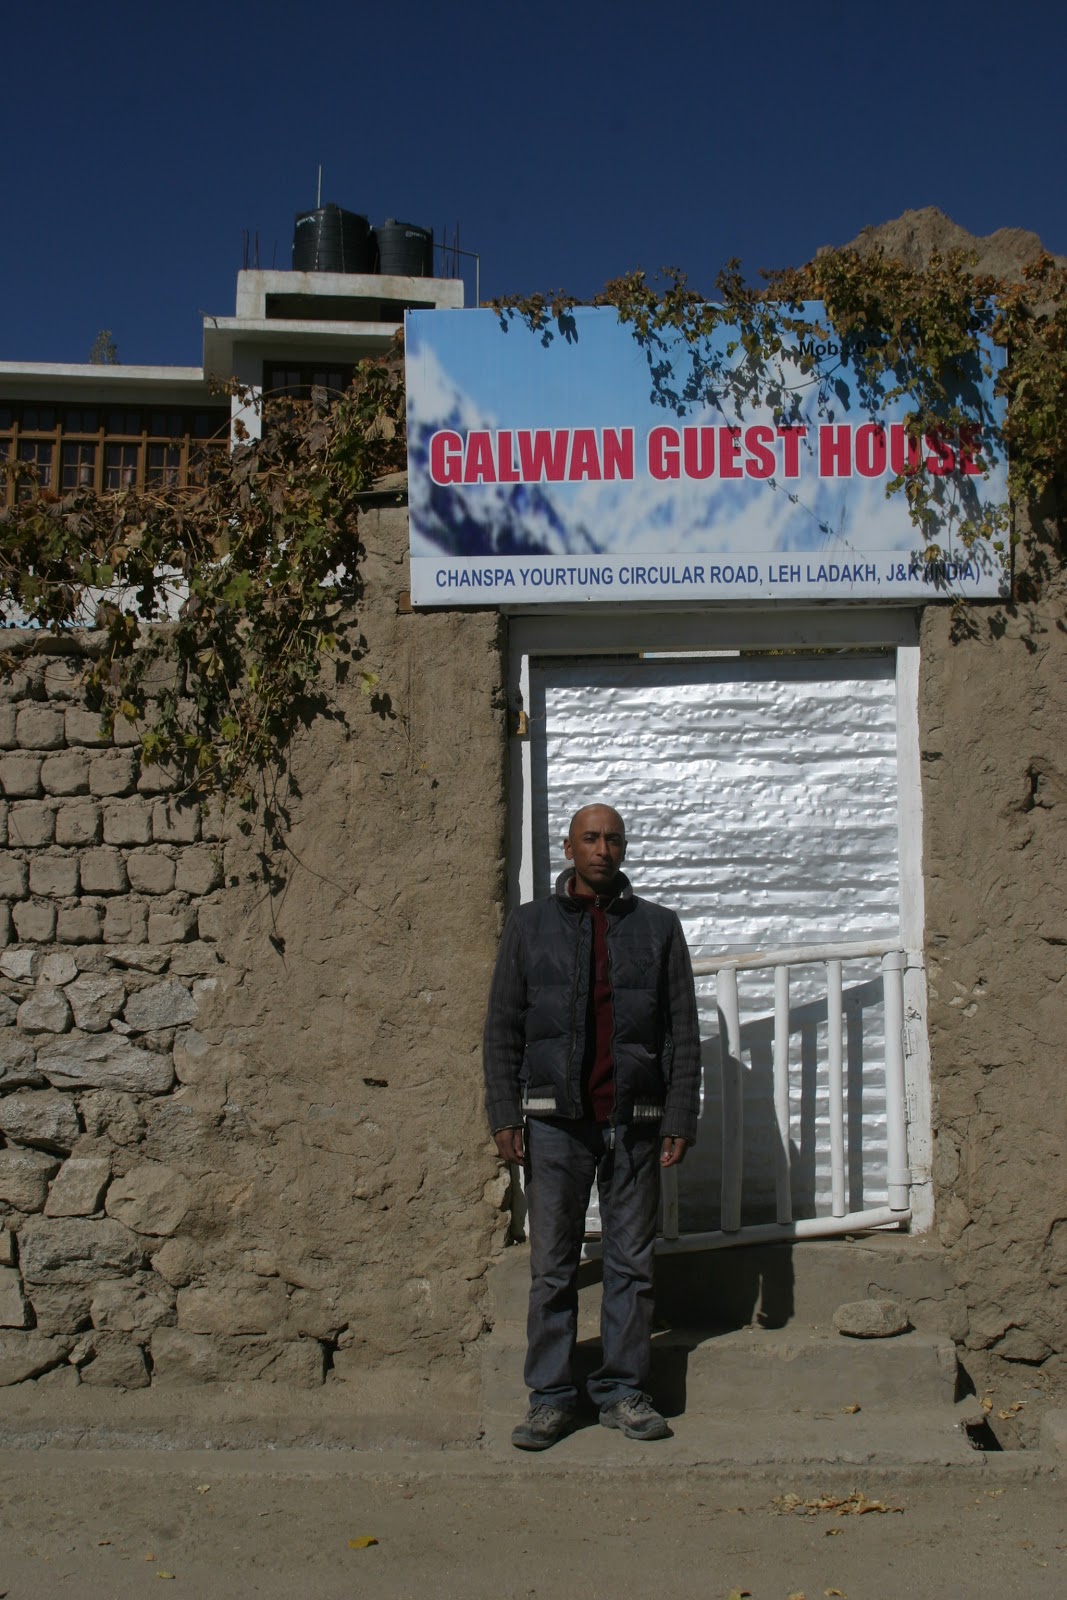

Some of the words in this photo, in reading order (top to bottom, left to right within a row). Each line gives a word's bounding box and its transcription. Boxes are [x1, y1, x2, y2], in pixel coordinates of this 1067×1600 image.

[431, 428, 634, 486] GALWAN
[648, 423, 807, 481] GUEST
[818, 423, 984, 478] HOUSE
[436, 569, 515, 587] CHANSPA
[519, 567, 614, 586] YOURTUNG
[618, 566, 705, 585] CIRCULAR
[710, 565, 763, 586] ROAD,
[769, 565, 801, 583] LEH
[807, 564, 881, 585] LADAKH,
[886, 564, 919, 582] J&K
[925, 562, 981, 586] (INDIA)
